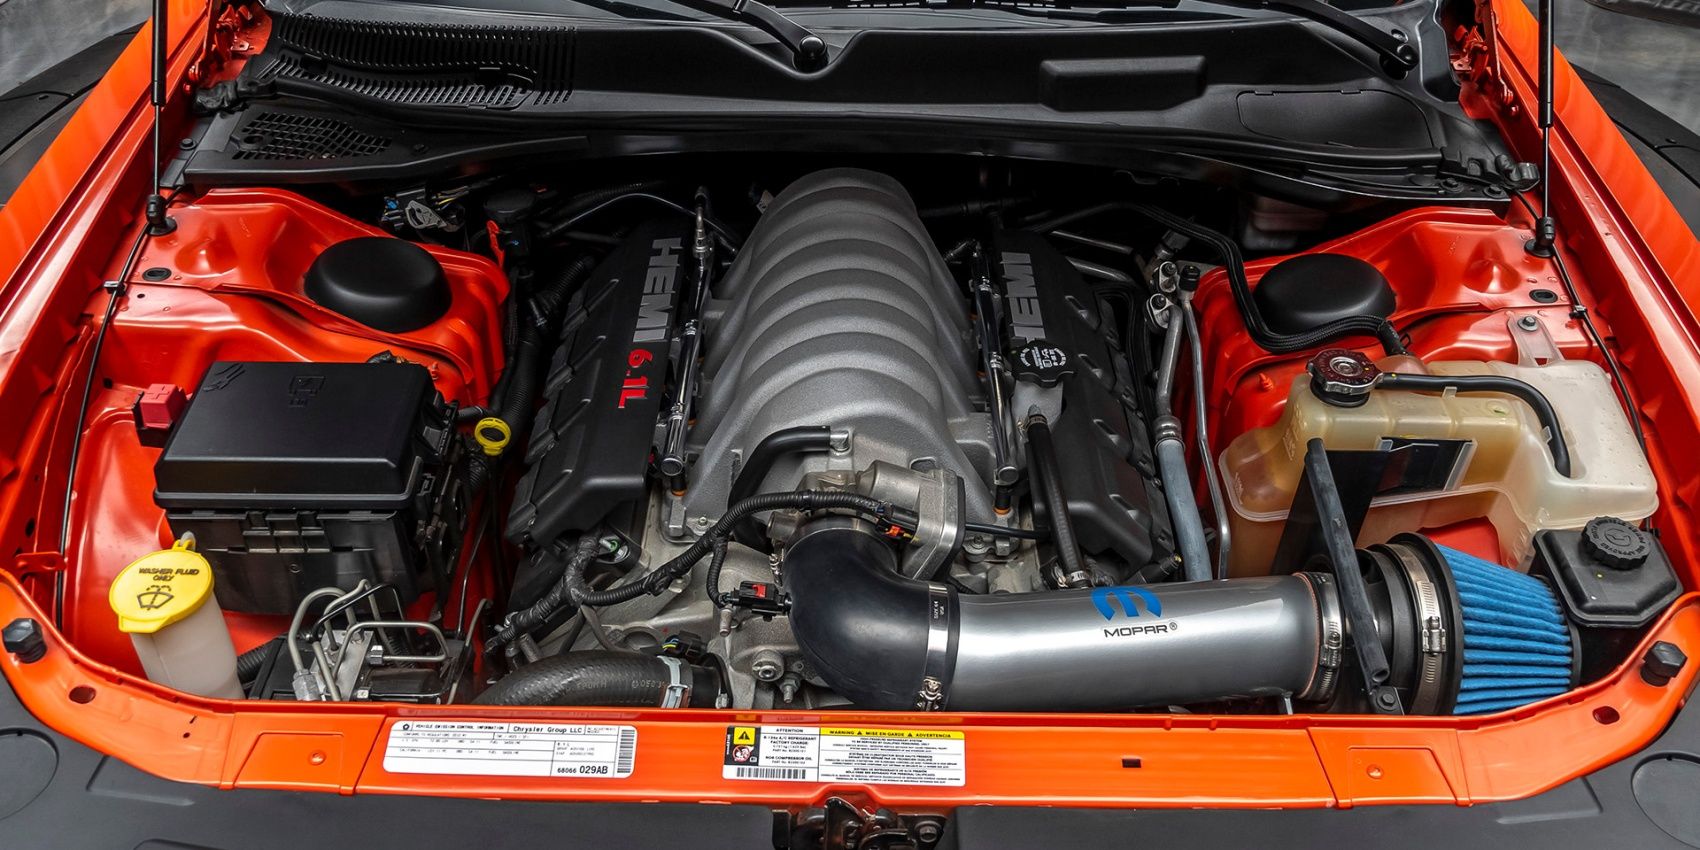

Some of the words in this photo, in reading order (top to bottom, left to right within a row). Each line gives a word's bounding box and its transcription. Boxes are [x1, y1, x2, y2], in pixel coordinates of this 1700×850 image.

[632, 237, 682, 342] HEMI
[618, 348, 653, 409] 6.1L
[513, 725, 544, 734] Chrysler
[547, 726, 567, 734] Group
[579, 765, 608, 774] 029AB
